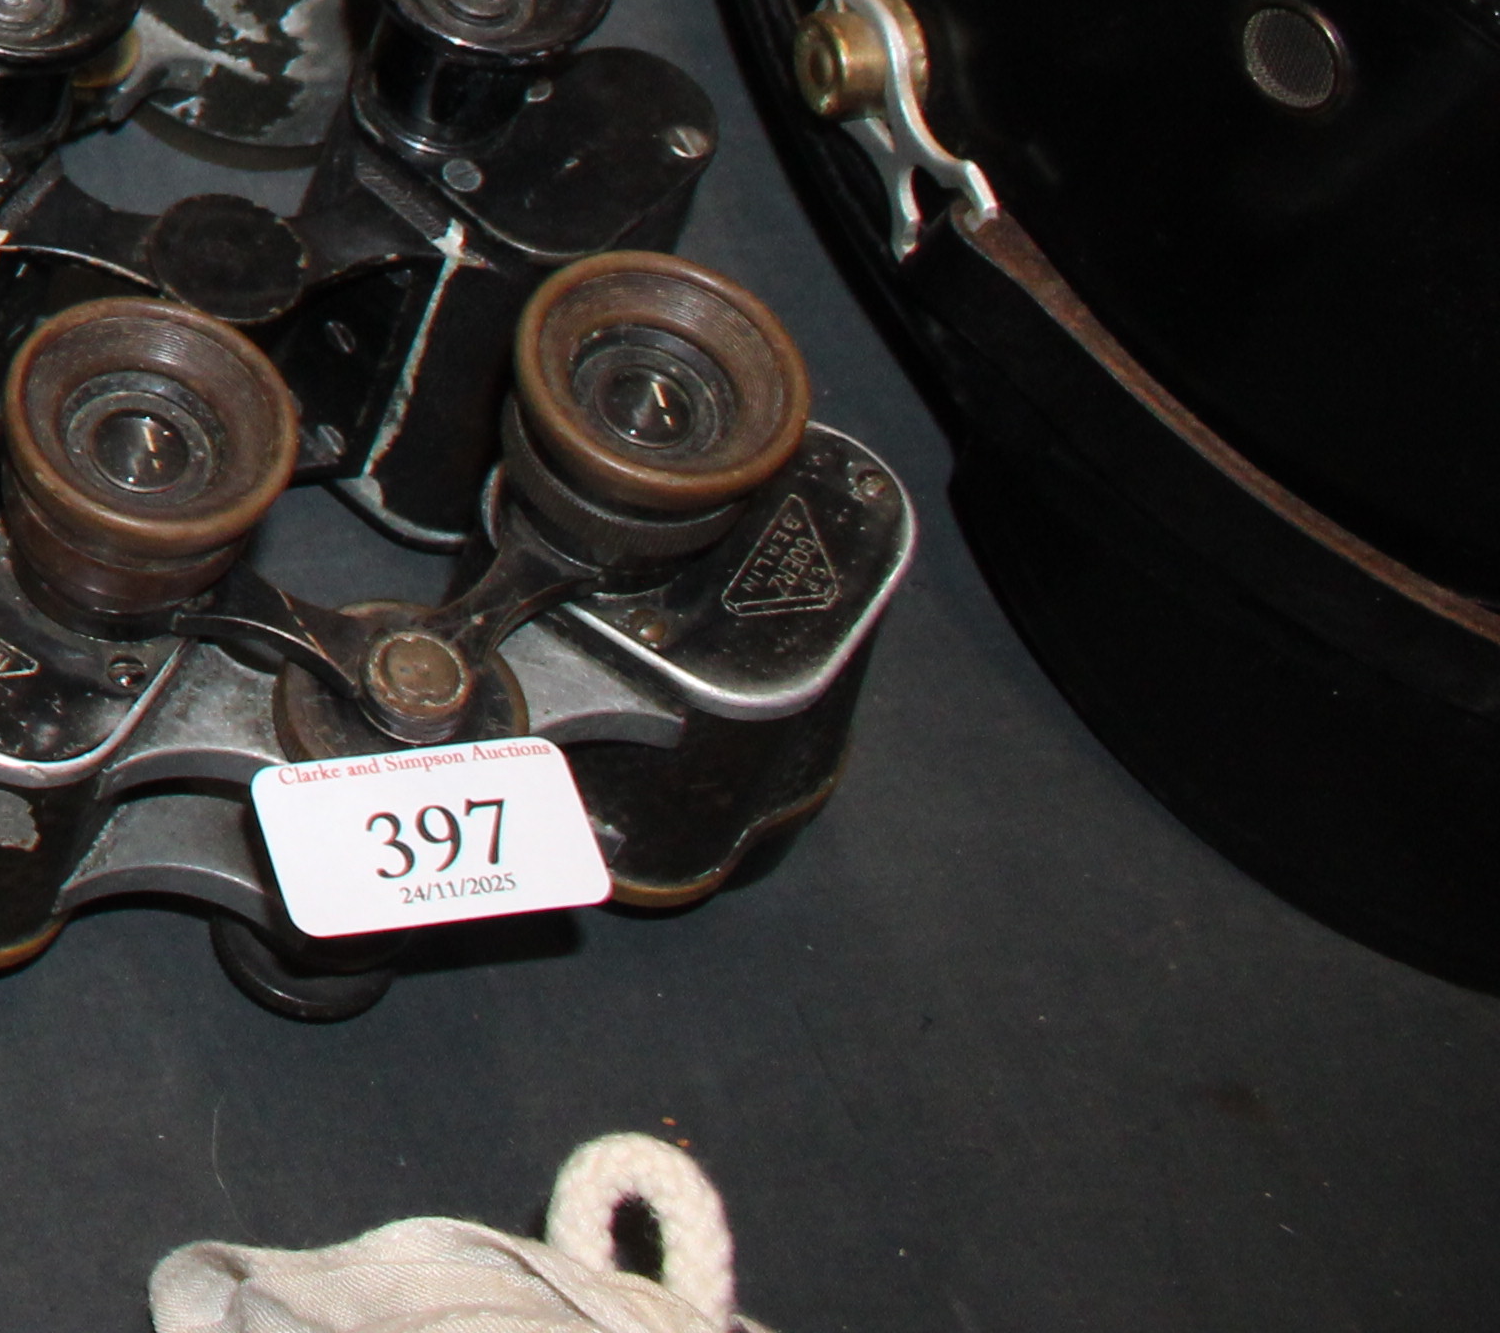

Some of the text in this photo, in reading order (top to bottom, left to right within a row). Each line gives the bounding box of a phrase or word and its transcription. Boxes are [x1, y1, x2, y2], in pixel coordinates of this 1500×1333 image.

[741, 513, 803, 593] BERLIN
[767, 537, 817, 597] GOERZ
[277, 740, 552, 787] Clarke and Simpson Auctions
[365, 797, 506, 881] 397
[398, 872, 517, 904] 24/11/2025
